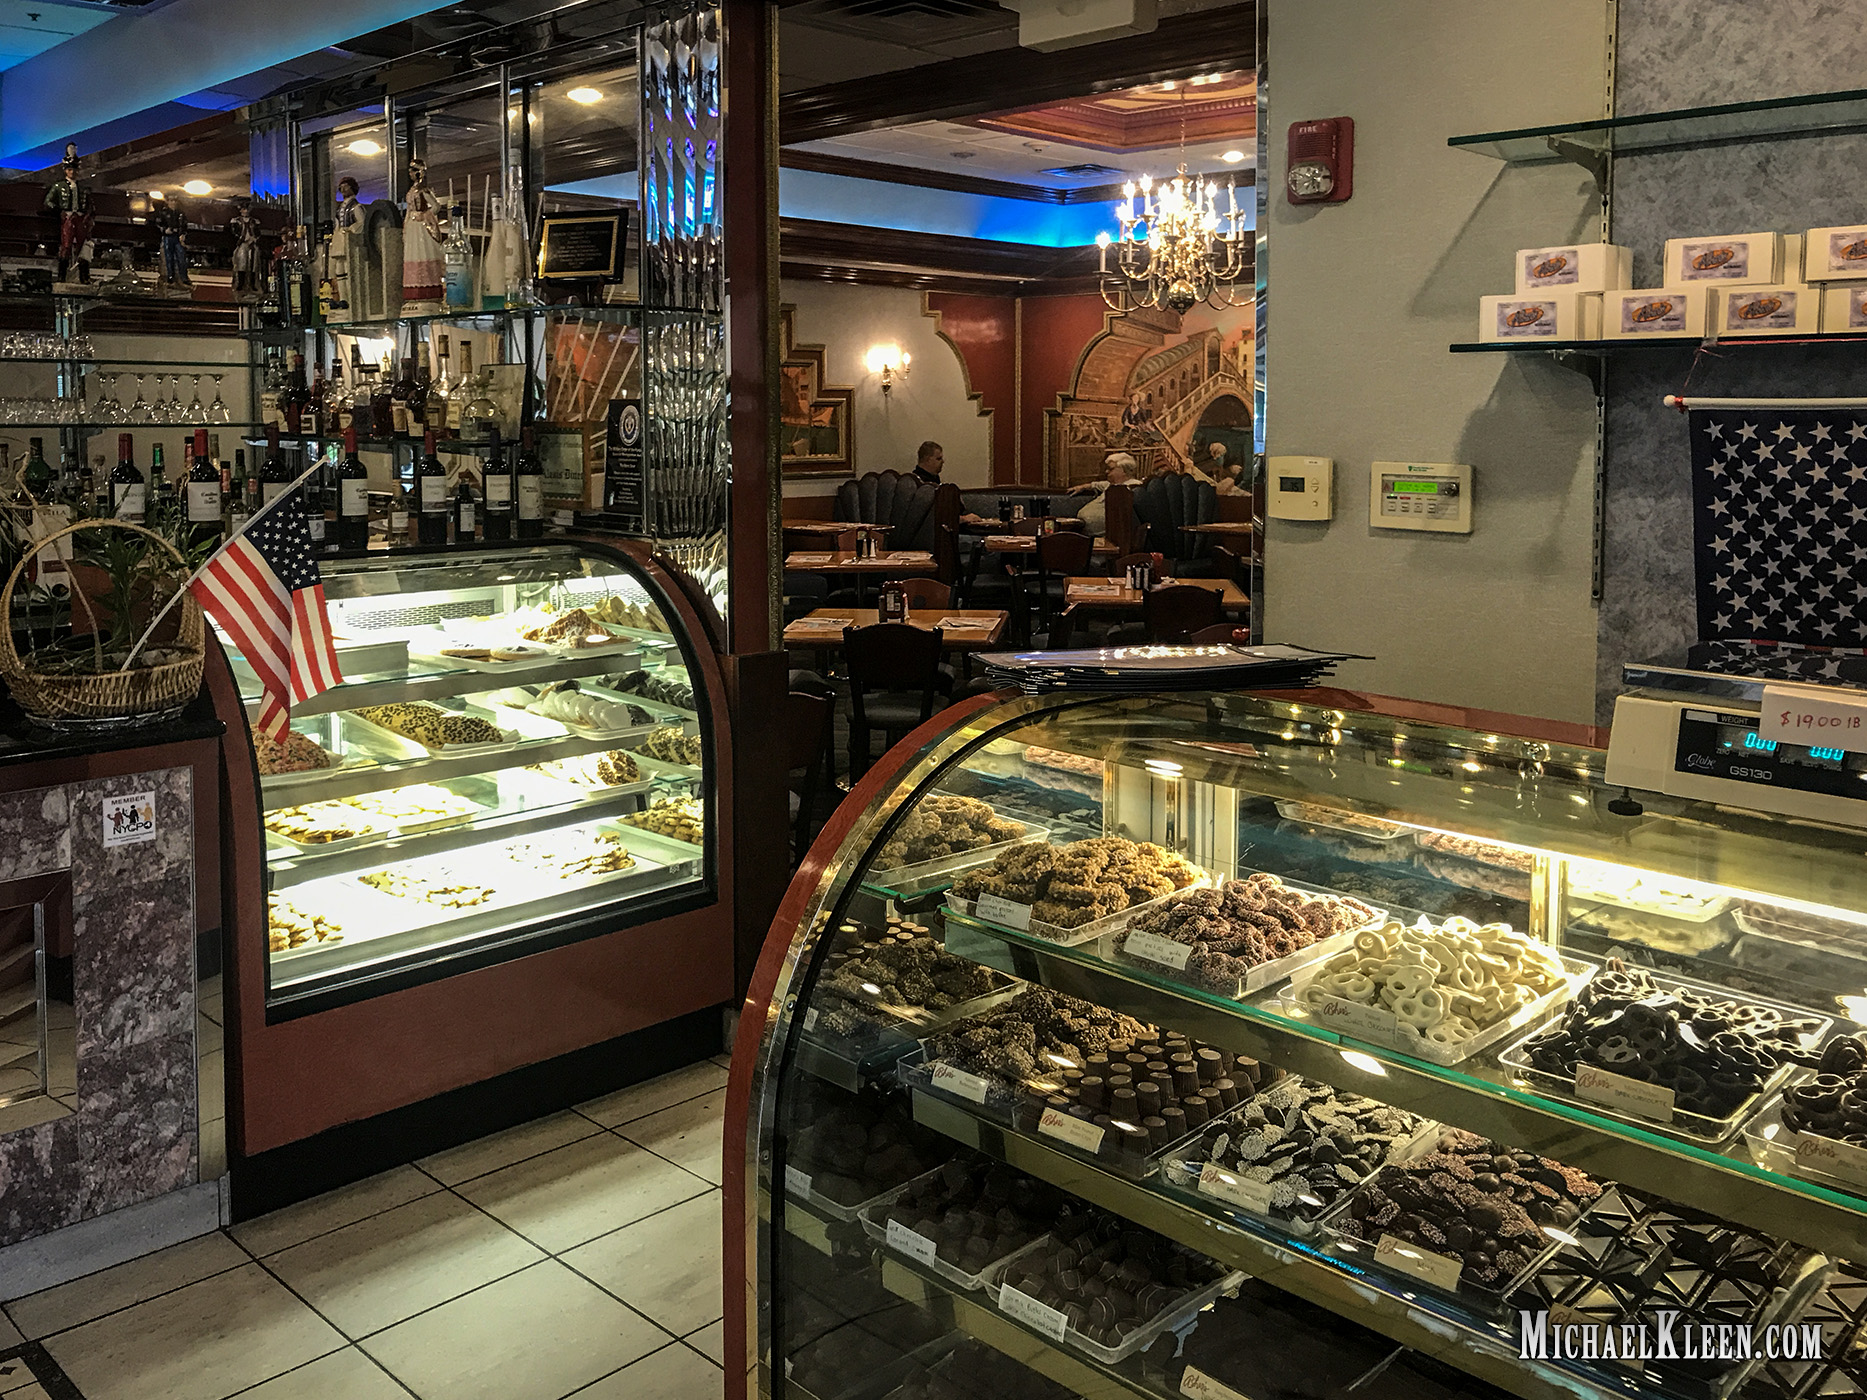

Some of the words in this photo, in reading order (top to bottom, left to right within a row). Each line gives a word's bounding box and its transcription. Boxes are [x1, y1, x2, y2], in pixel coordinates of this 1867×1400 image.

[1299, 125, 1318, 135] FIRE
[1720, 714, 1749, 726] WEIGHT
[1685, 752, 1717, 770] Globe
[1729, 764, 1773, 781] GS130
[111, 795, 147, 806] MEMBER
